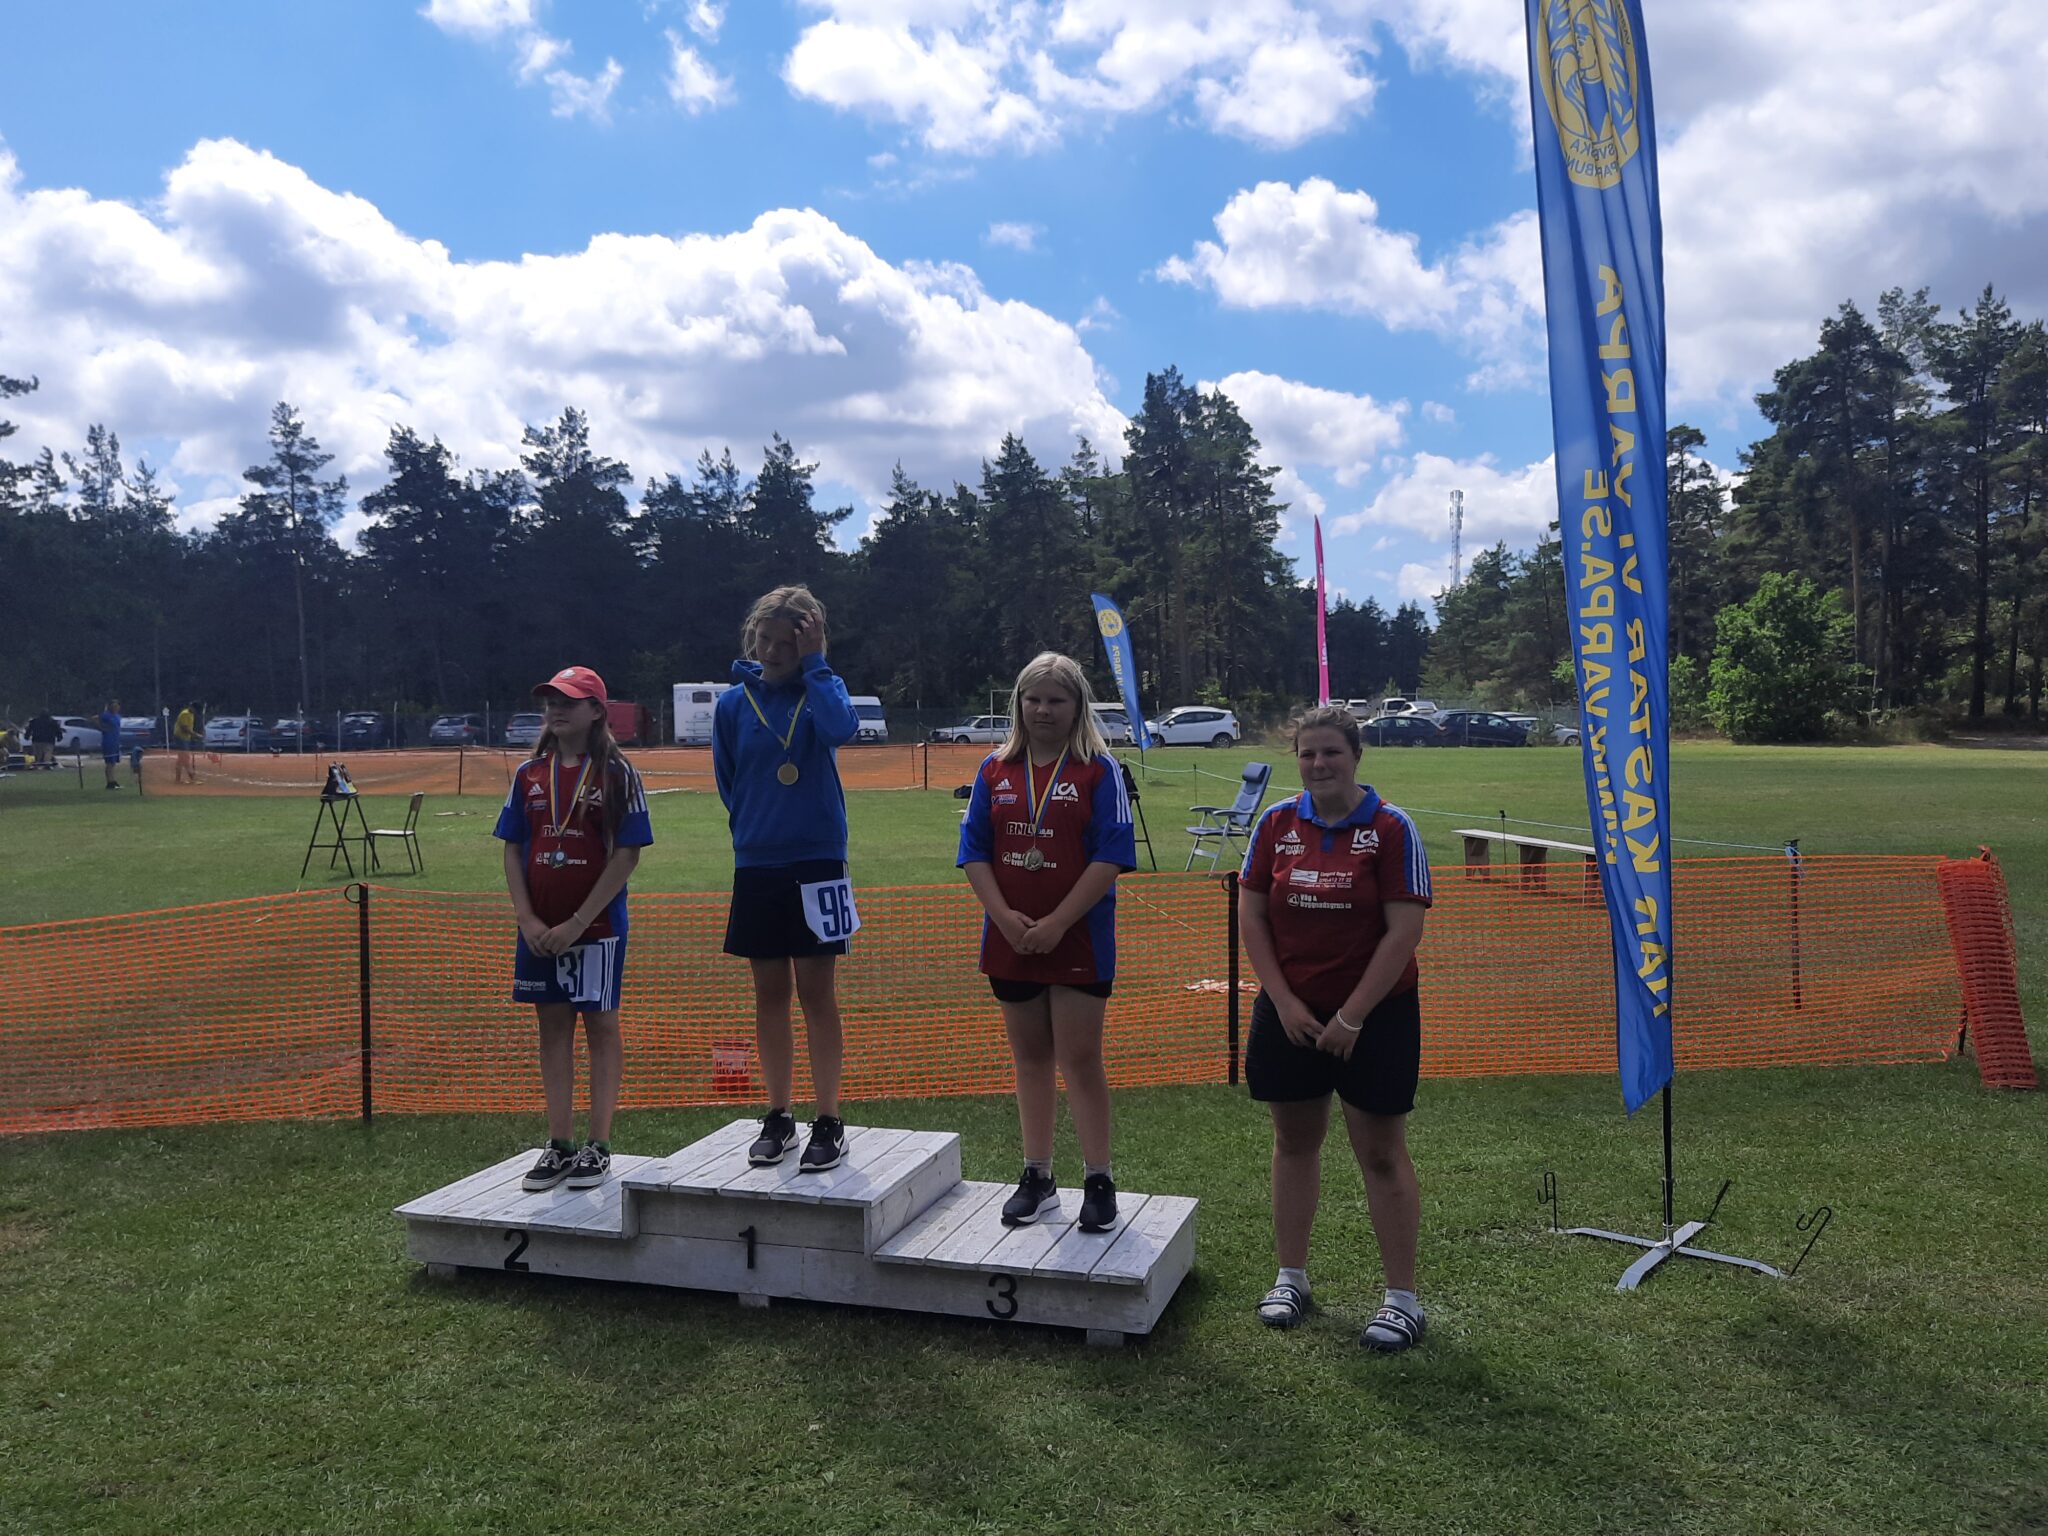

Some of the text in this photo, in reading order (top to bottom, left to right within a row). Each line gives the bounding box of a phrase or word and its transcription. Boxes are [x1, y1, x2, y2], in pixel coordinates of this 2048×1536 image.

[1052, 782, 1079, 796] ICA
[1353, 828, 1380, 844] ICA
[817, 884, 852, 937] 96
[503, 1229, 530, 1271] 2
[738, 1225, 756, 1269] 1
[986, 1273, 1019, 1320] 3
[1265, 1290, 1293, 1301] FILA
[1375, 1311, 1407, 1328] FILA
